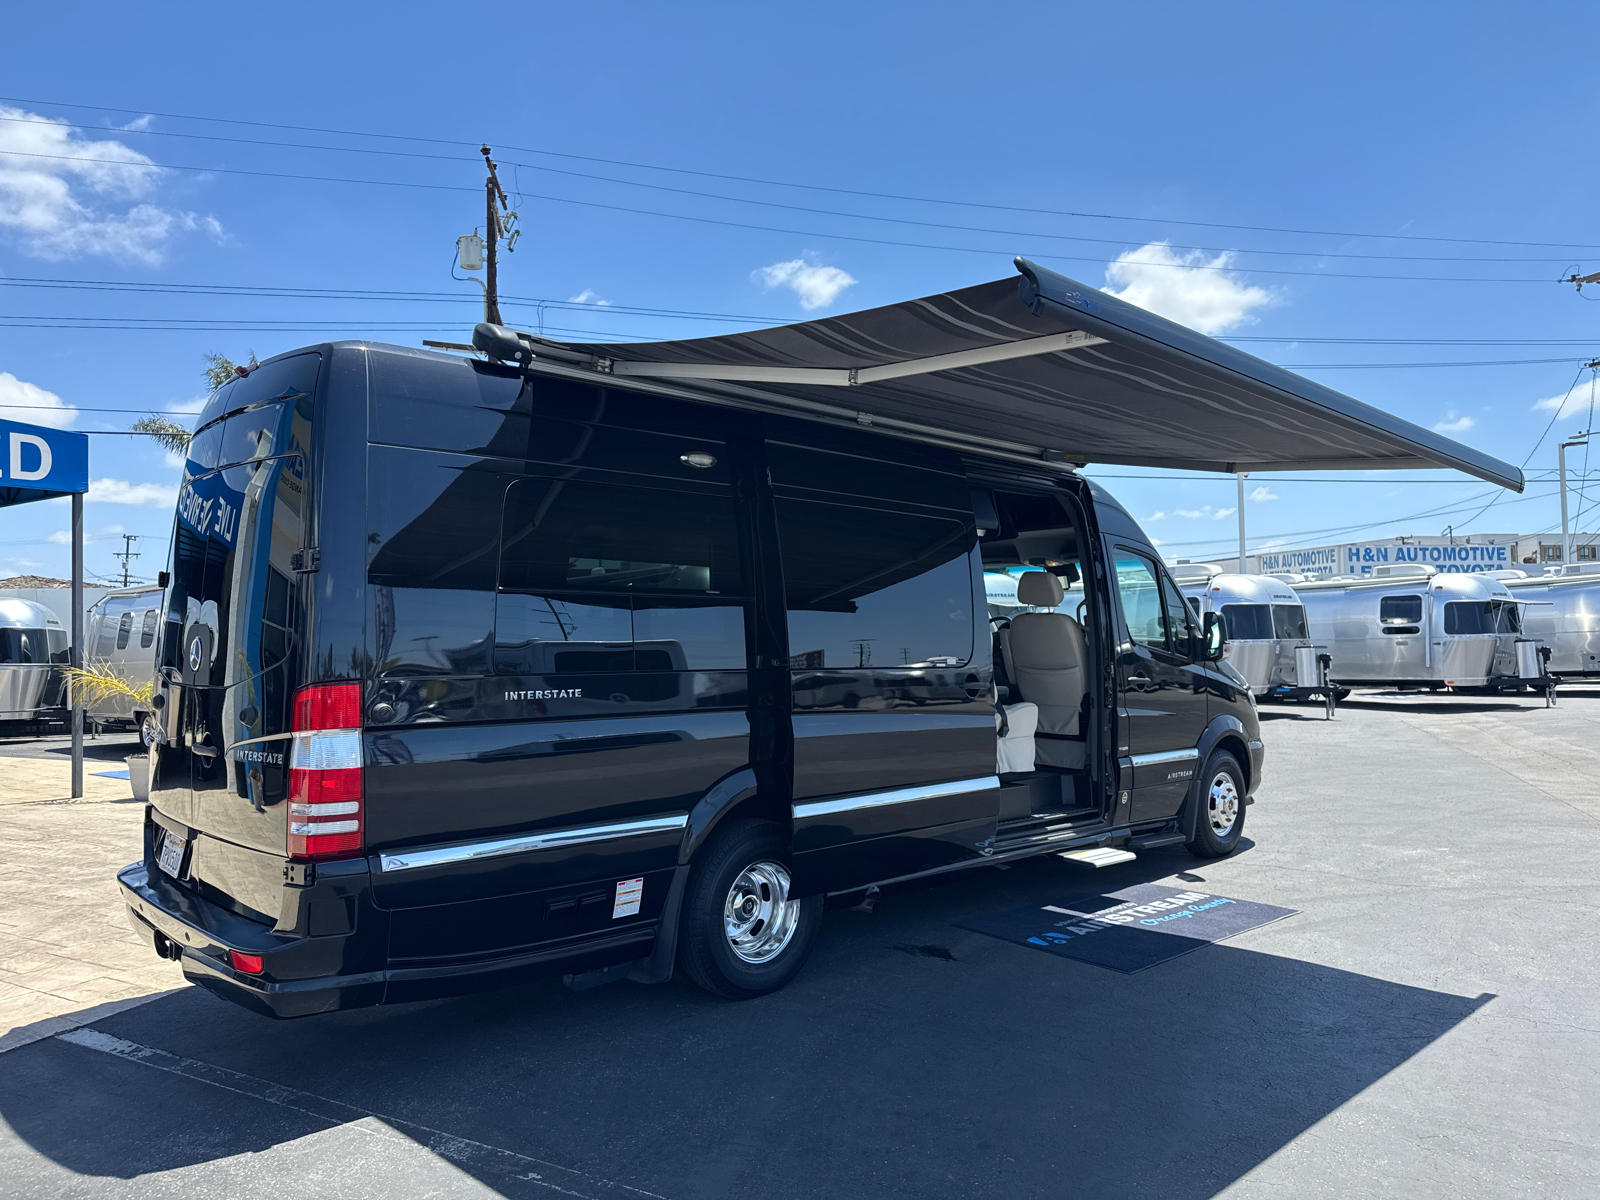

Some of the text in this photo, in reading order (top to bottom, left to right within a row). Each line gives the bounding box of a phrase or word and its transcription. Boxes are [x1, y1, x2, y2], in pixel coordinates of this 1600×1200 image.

[0, 432, 53, 481] D
[1262, 549, 1336, 570] H&N AUTOMOTIVE
[1348, 547, 1507, 562] H&N AUTOMOTIVE
[504, 689, 582, 700] INTERSTATE
[236, 750, 283, 764] INTERSTATE
[1167, 770, 1193, 779] AIRSTREAM
